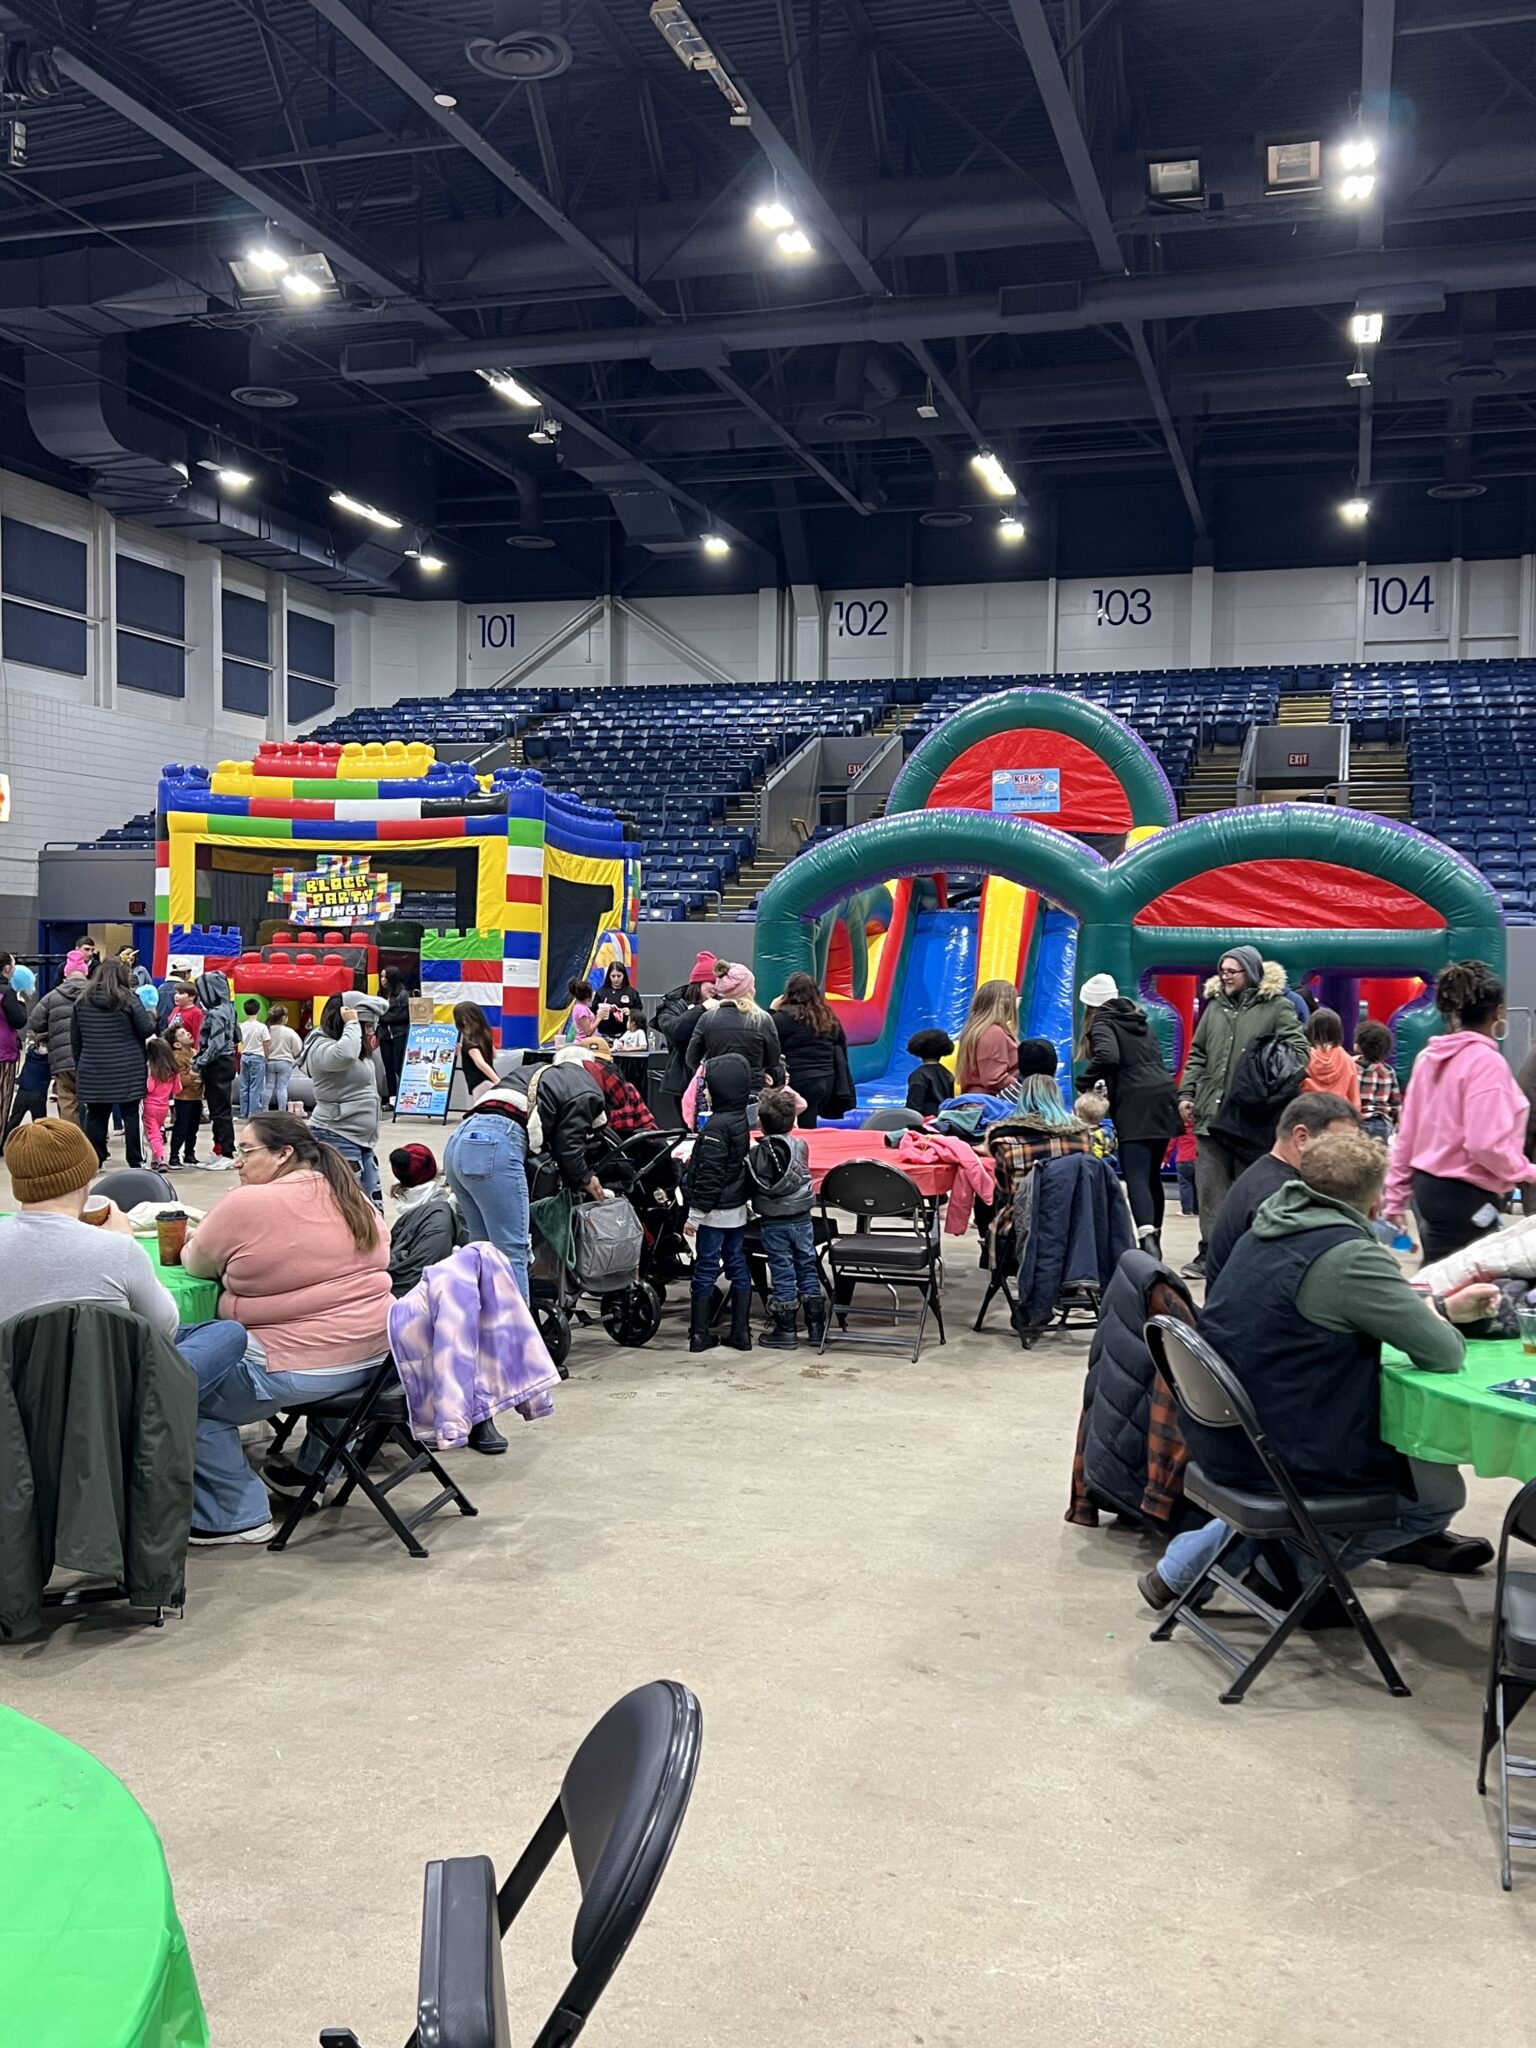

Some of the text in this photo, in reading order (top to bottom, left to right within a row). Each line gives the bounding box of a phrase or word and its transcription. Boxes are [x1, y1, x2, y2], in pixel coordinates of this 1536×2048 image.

[1368, 575, 1435, 615] 104
[1092, 588, 1152, 626] 103
[833, 600, 889, 637] 102
[477, 614, 515, 648] 101
[1289, 754, 1308, 765] EXIT
[848, 764, 863, 774] EXI
[305, 874, 369, 893] BLOCK
[312, 889, 375, 906] PARTY
[308, 903, 369, 919] COMBO
[415, 1036, 450, 1045] RENTALS
